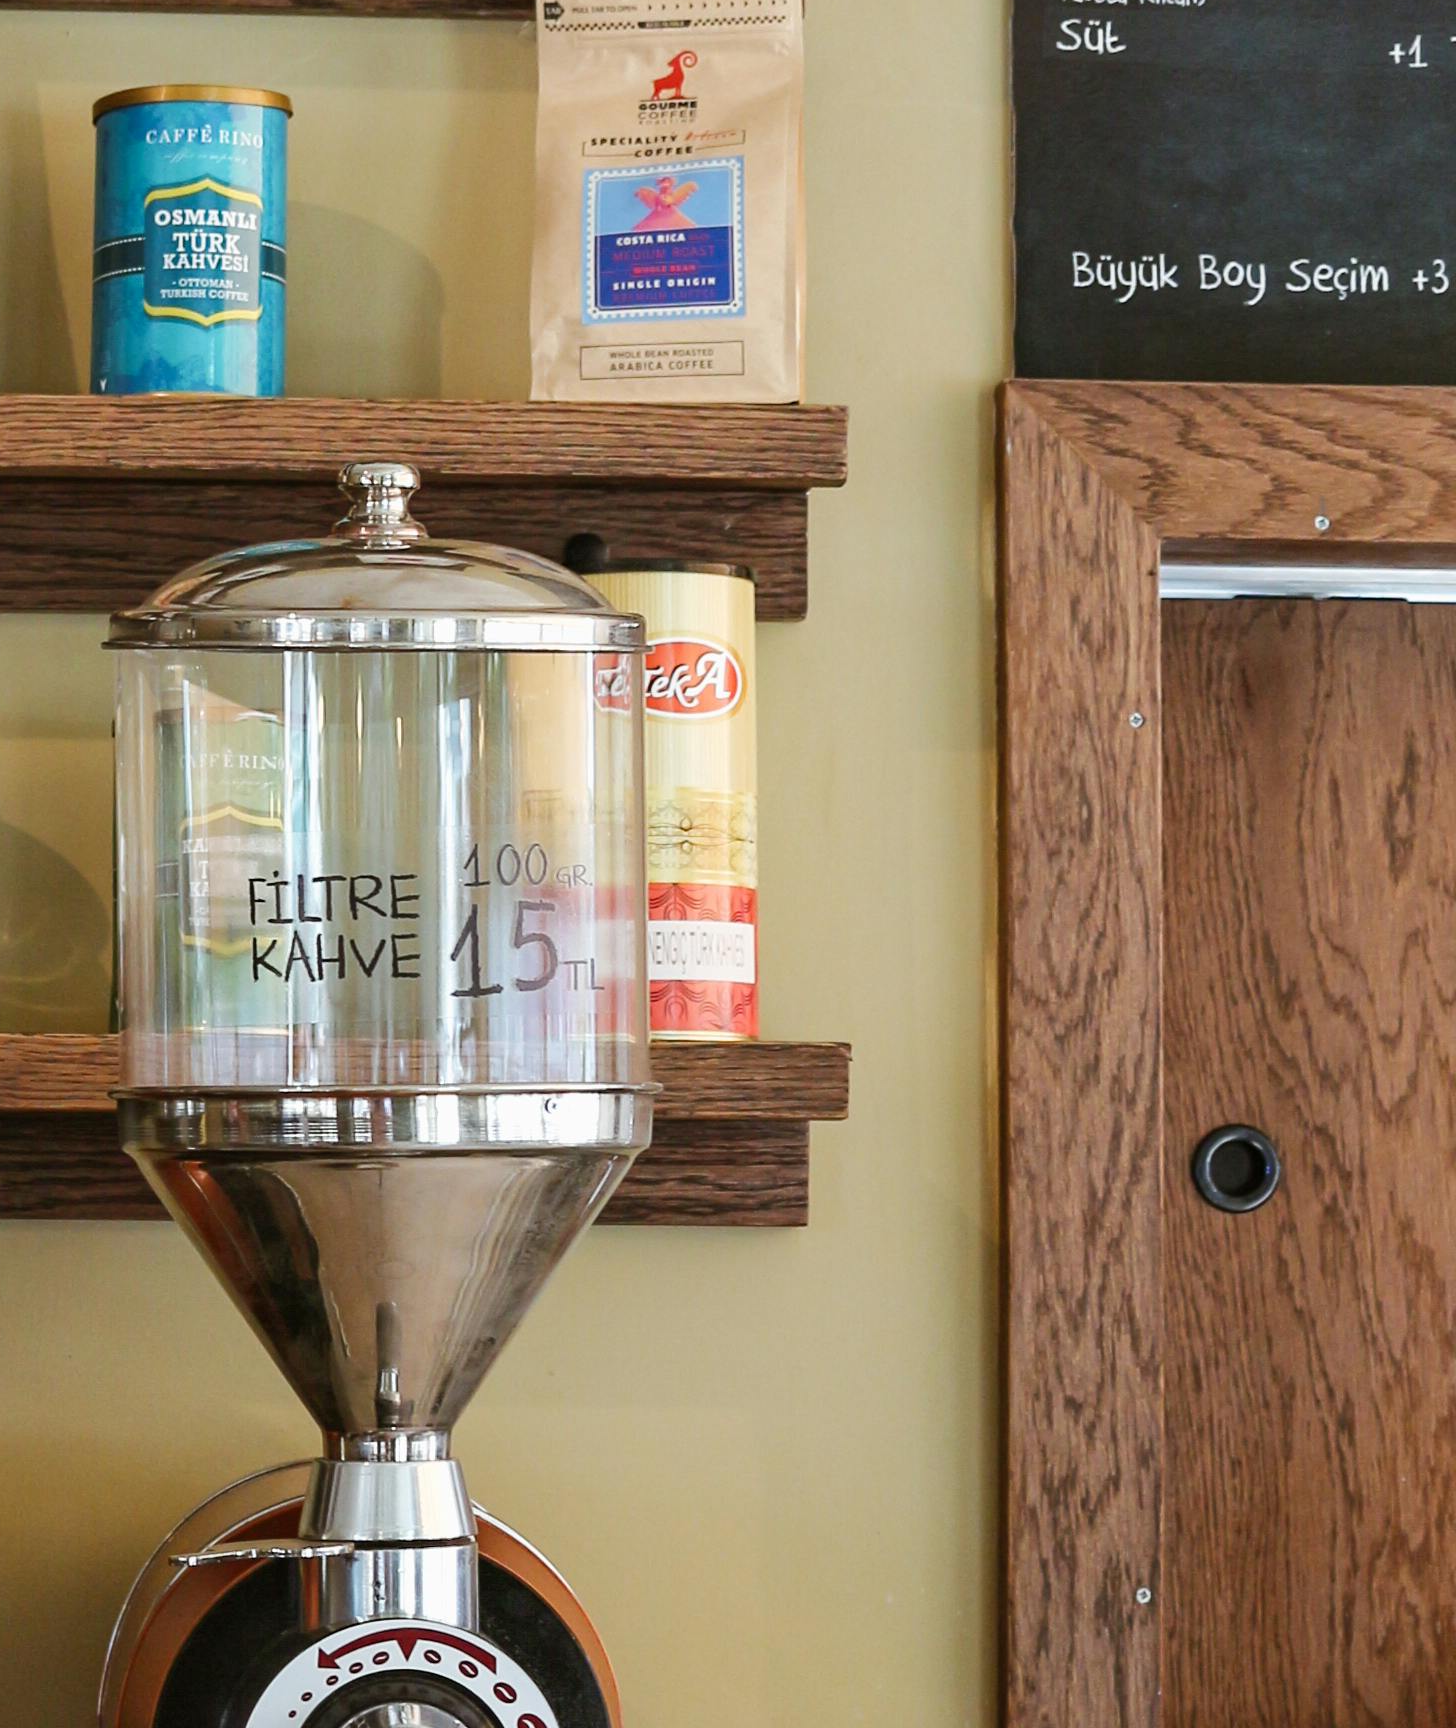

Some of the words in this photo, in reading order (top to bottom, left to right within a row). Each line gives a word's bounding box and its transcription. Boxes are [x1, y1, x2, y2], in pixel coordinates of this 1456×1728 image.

[1056, 18, 1127, 55] Süt
[638, 110, 696, 120] COFFEE
[639, 101, 697, 110] GOURME
[146, 124, 212, 146] CAFFÈ
[219, 131, 263, 149] RINO
[591, 135, 678, 147] SPECIALITY
[634, 146, 693, 157] COFFEE
[154, 208, 257, 231] OSMANLI
[172, 228, 241, 255] TÜRK
[616, 235, 653, 246] COSTA
[657, 233, 686, 244] RICA
[162, 253, 249, 273] KAHVESİ
[179, 278, 233, 289] OTTOMAN
[613, 280, 661, 291] SINGLE
[667, 277, 716, 288] ORIGIN
[1072, 251, 1179, 303] Büyük
[1199, 254, 1266, 306] Boy
[1285, 257, 1390, 301] Seçim
[1412, 258, 1449, 294] +3
[160, 289, 206, 300] TURKISH
[209, 290, 249, 302] COFFEE
[609, 362, 663, 371] ARABICA
[669, 360, 713, 370] COFFEE
[464, 843, 548, 887] 100
[248, 870, 420, 925] FİLTRE
[252, 930, 421, 982] KAHVE
[450, 899, 559, 998] 15
[563, 957, 605, 992] TL
